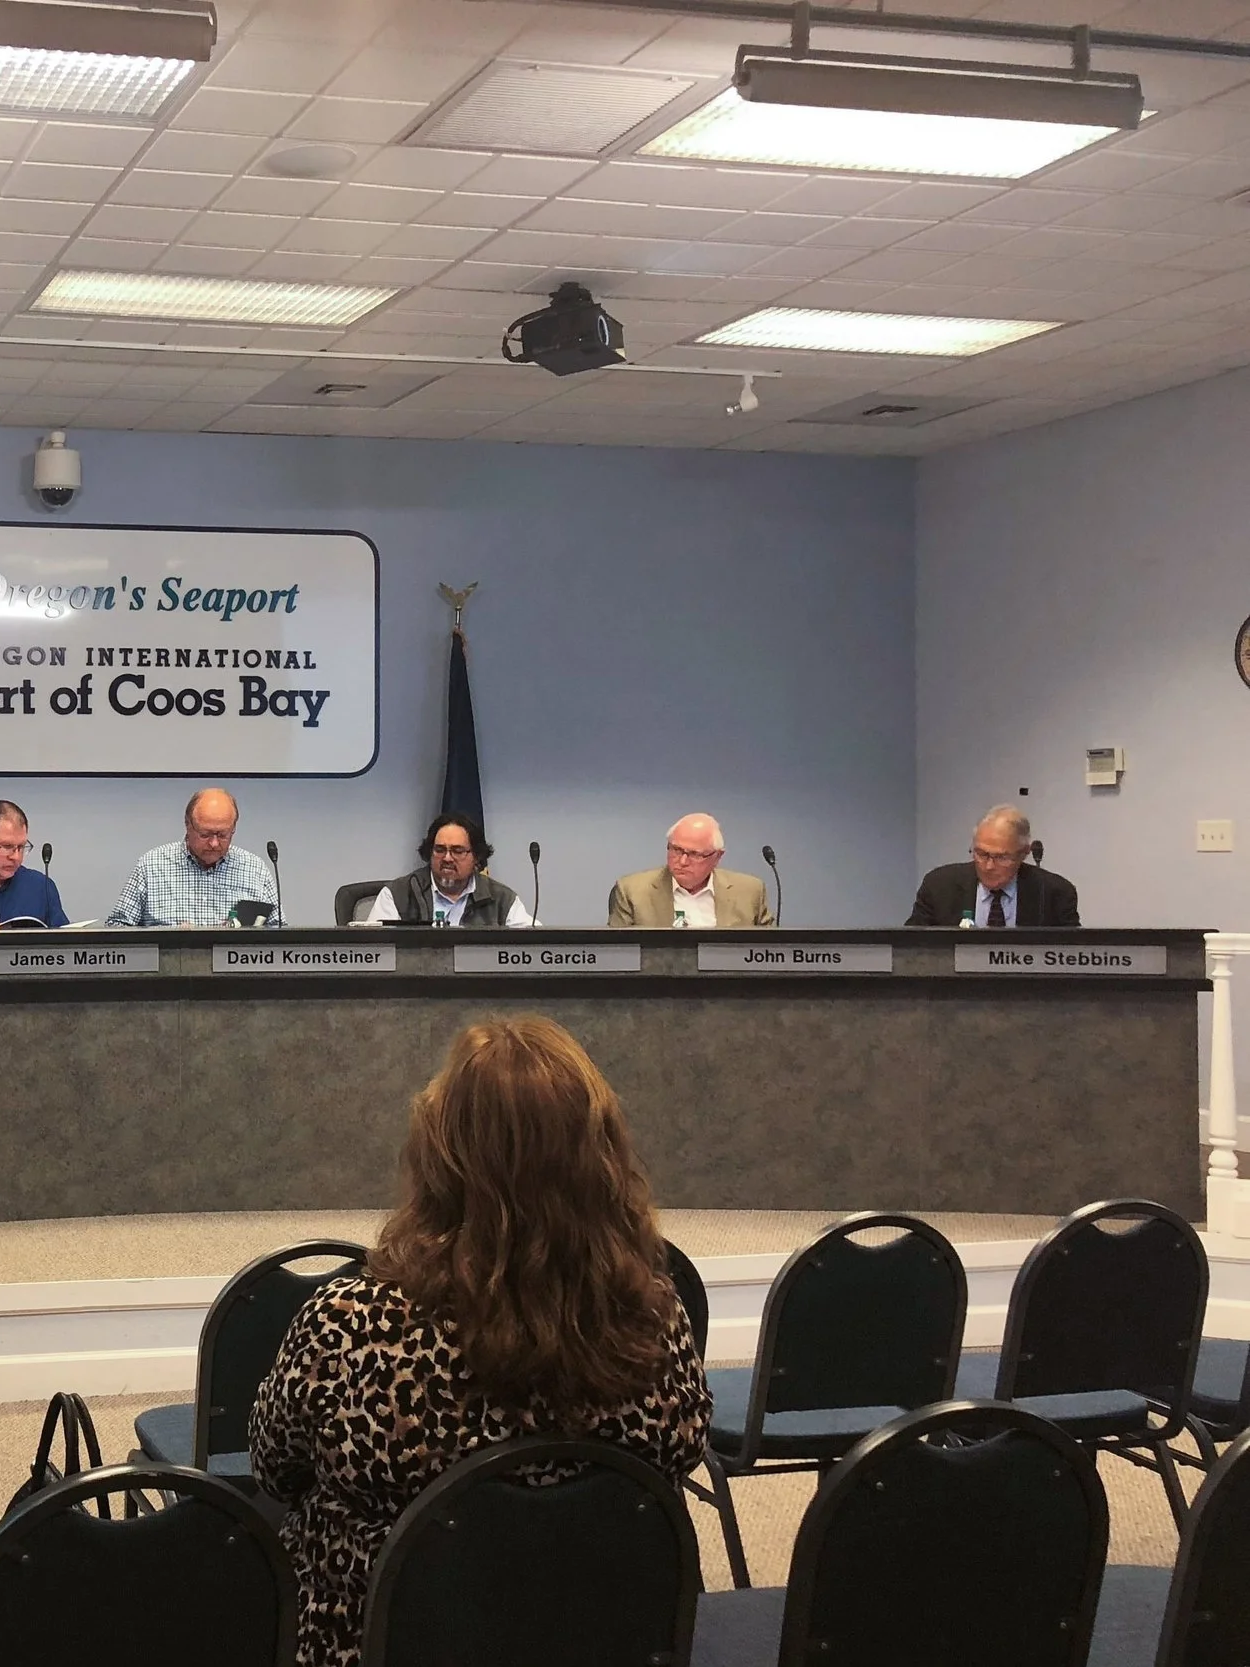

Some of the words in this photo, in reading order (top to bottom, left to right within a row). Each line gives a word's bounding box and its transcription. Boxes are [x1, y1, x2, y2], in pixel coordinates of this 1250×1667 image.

[156, 576, 300, 622] Seaport
[85, 647, 317, 670] INTERNATIONAL
[48, 673, 93, 716] of
[108, 673, 226, 717] Coos
[238, 675, 331, 728] Bay
[9, 951, 67, 967] James
[73, 950, 126, 965] Martin
[226, 948, 274, 965] David
[282, 948, 382, 964] Kronsteiner
[498, 950, 532, 965] Bob
[540, 950, 597, 965] Garcia
[743, 949, 785, 964] John
[792, 949, 842, 964] Burns
[989, 950, 1034, 966] Mike
[1044, 950, 1132, 967] Stebbins
